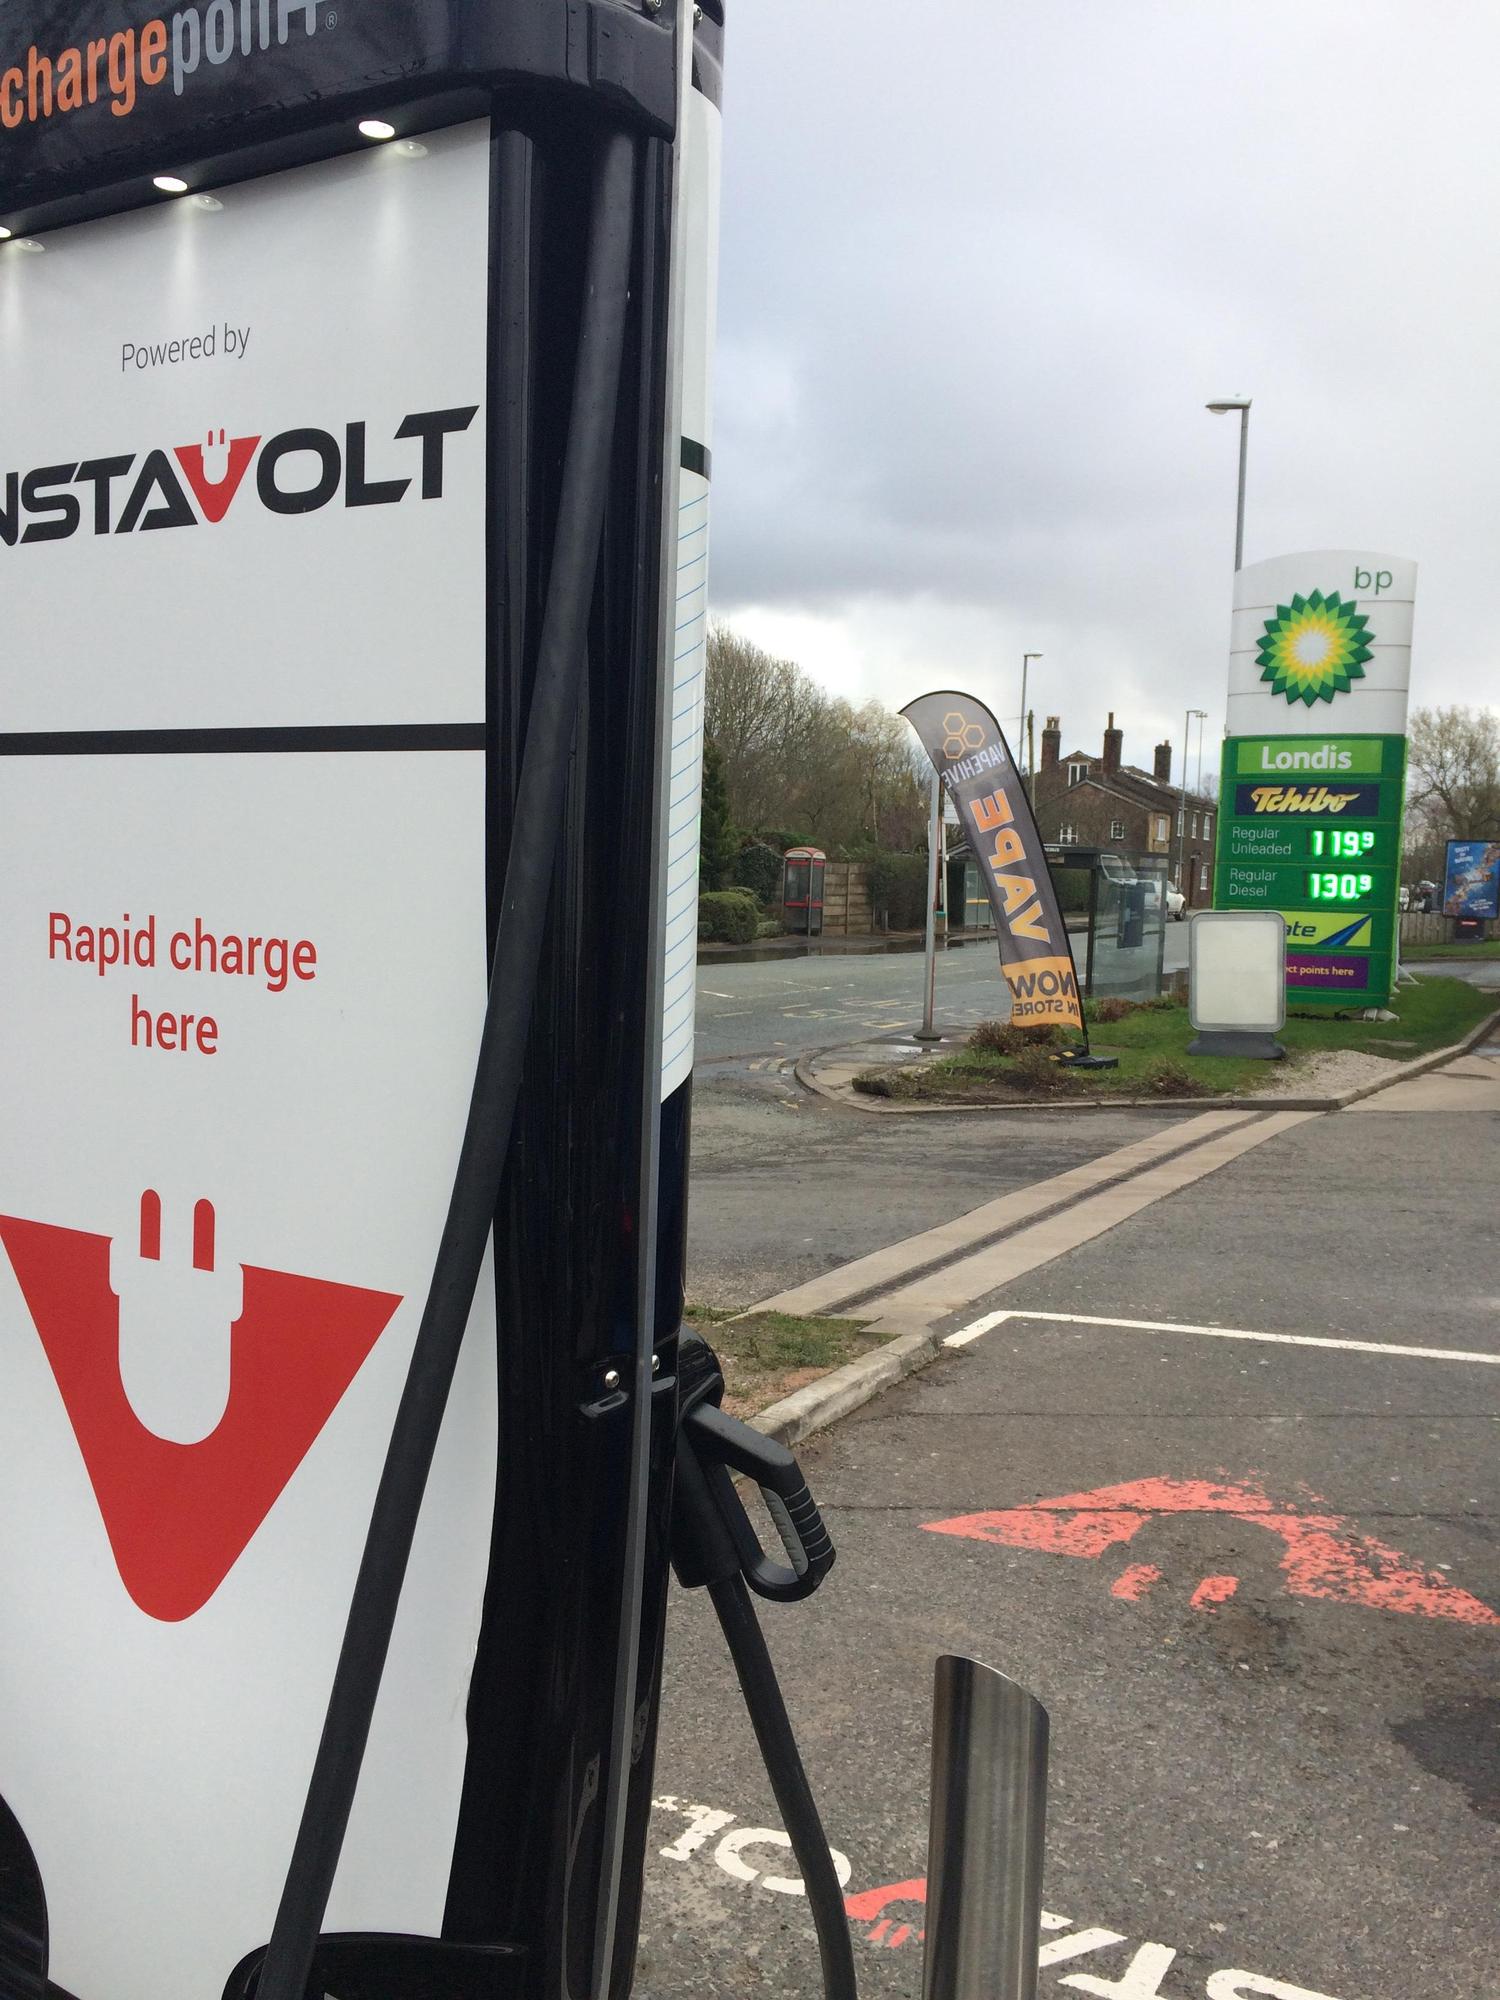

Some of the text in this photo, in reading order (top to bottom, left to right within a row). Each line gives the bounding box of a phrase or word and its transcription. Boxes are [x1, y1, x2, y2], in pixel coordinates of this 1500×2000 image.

[122, 323, 250, 372] Powered by
[1354, 566, 1392, 595] bp
[1261, 745, 1353, 770] Londis
[1251, 787, 1360, 813] Tchibo
[1232, 826, 1280, 841] Regular
[1231, 842, 1291, 855] Unleaded
[1229, 868, 1278, 883] Regular
[1229, 883, 1267, 896] Diesel
[49, 912, 317, 992] Rapid charge
[1299, 965, 1329, 976] points
[1331, 966, 1354, 976] here
[131, 994, 218, 1055] here
